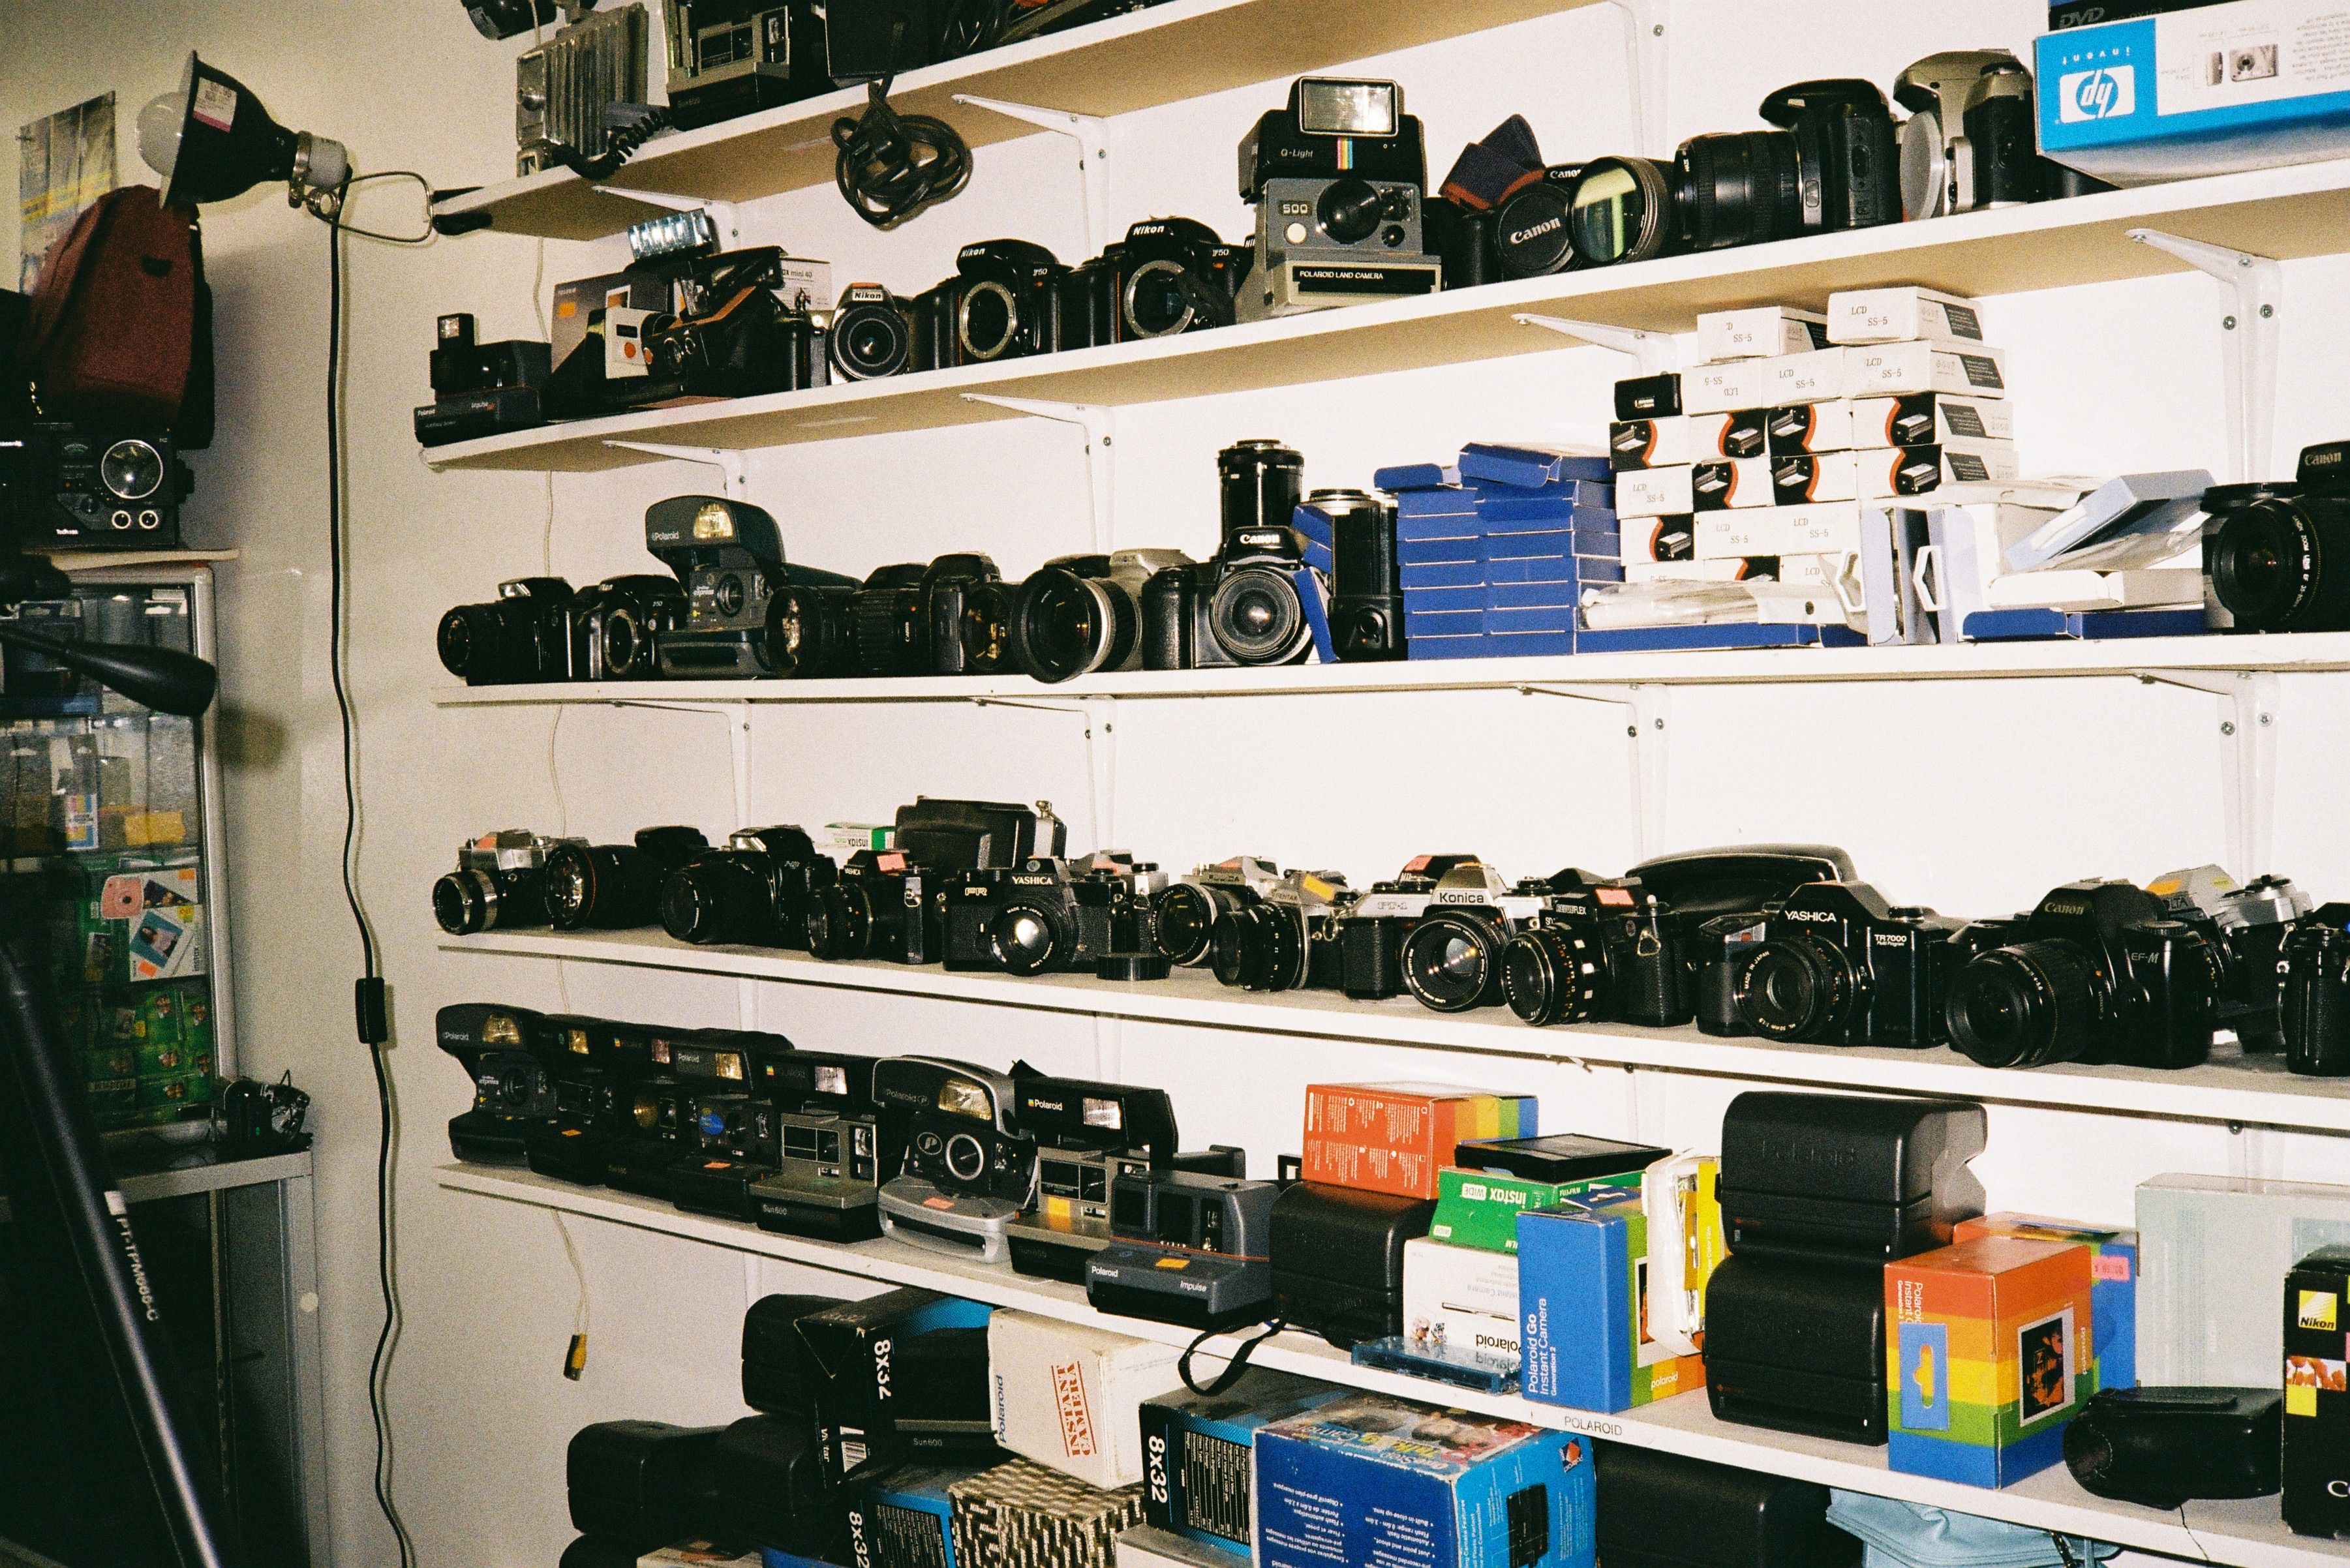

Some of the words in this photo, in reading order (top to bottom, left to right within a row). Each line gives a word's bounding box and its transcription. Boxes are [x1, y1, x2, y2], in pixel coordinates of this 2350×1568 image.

[2059, 7, 2105, 29] DVD
[2062, 46, 2131, 65] invent
[2081, 69, 2113, 119] hp
[1281, 149, 1313, 158] Q-Light
[1283, 204, 1308, 214] 500
[1133, 225, 1165, 236] Nikon
[1510, 217, 1561, 245] Canon
[960, 247, 986, 258] Nikon
[1852, 306, 1868, 316] LCD
[1868, 316, 1888, 326] SS-5
[1733, 333, 1752, 343] SS-5
[1867, 357, 1882, 367] LCD
[1779, 369, 1794, 378] LCD
[1882, 369, 1902, 378] SS-5
[1704, 376, 1723, 385] SS-5
[1795, 379, 1815, 389] SS-5
[1724, 387, 1739, 397] LCD
[2304, 451, 2342, 467] Canon
[1647, 494, 1664, 502] SS-5
[1717, 524, 1730, 532] LCD
[1793, 518, 1808, 527] LCD
[654, 531, 680, 541] Polaroid
[1240, 533, 1280, 546] Canon
[1730, 535, 1748, 544] SS-5
[2301, 534, 2310, 551] ZOOM
[1805, 566, 1820, 576] LCD
[847, 837, 868, 847] instax
[1012, 876, 1054, 886] YASHICA
[964, 887, 988, 896] FR
[1439, 892, 1484, 903] Konica
[2044, 902, 2084, 915] Canon
[1784, 911, 1837, 923] YASHICA
[2131, 952, 2159, 964] EF-M
[1744, 973, 1752, 989] MADE
[1754, 950, 1770, 964] JAPAN
[446, 1032, 469, 1041] Polaroid
[1034, 1099, 1063, 1111] Polaroid
[1463, 1184, 1486, 1199] WIDE
[1489, 1186, 1527, 1209] instax
[1091, 1266, 1118, 1278] Polaroid
[1180, 1280, 1207, 1292] Impulse
[1904, 1280, 1913, 1317] Instant
[1527, 1314, 1537, 1335] Go
[1538, 1298, 1548, 1349] Camera
[2300, 1316, 2335, 1331] Nikon
[1528, 1336, 1538, 1394] Polaroid
[1540, 1354, 1549, 1396] Instant
[1651, 1372, 1679, 1389] polaroid
[1056, 1364, 1081, 1456] INSTANT
[1066, 1362, 1091, 1456] CAMERA
[1564, 1416, 1623, 1436] POLAROID
[913, 1438, 943, 1447] Sun600
[1148, 1435, 1168, 1503] 8x32
[1385, 1509, 1407, 1522] close-up
[1325, 1517, 1339, 1526] Flash
[1387, 1531, 1400, 1539] flash
[1414, 1529, 1429, 1537] Flash
[1401, 1532, 1429, 1546] Automatic
[1403, 1545, 1417, 1554] point
